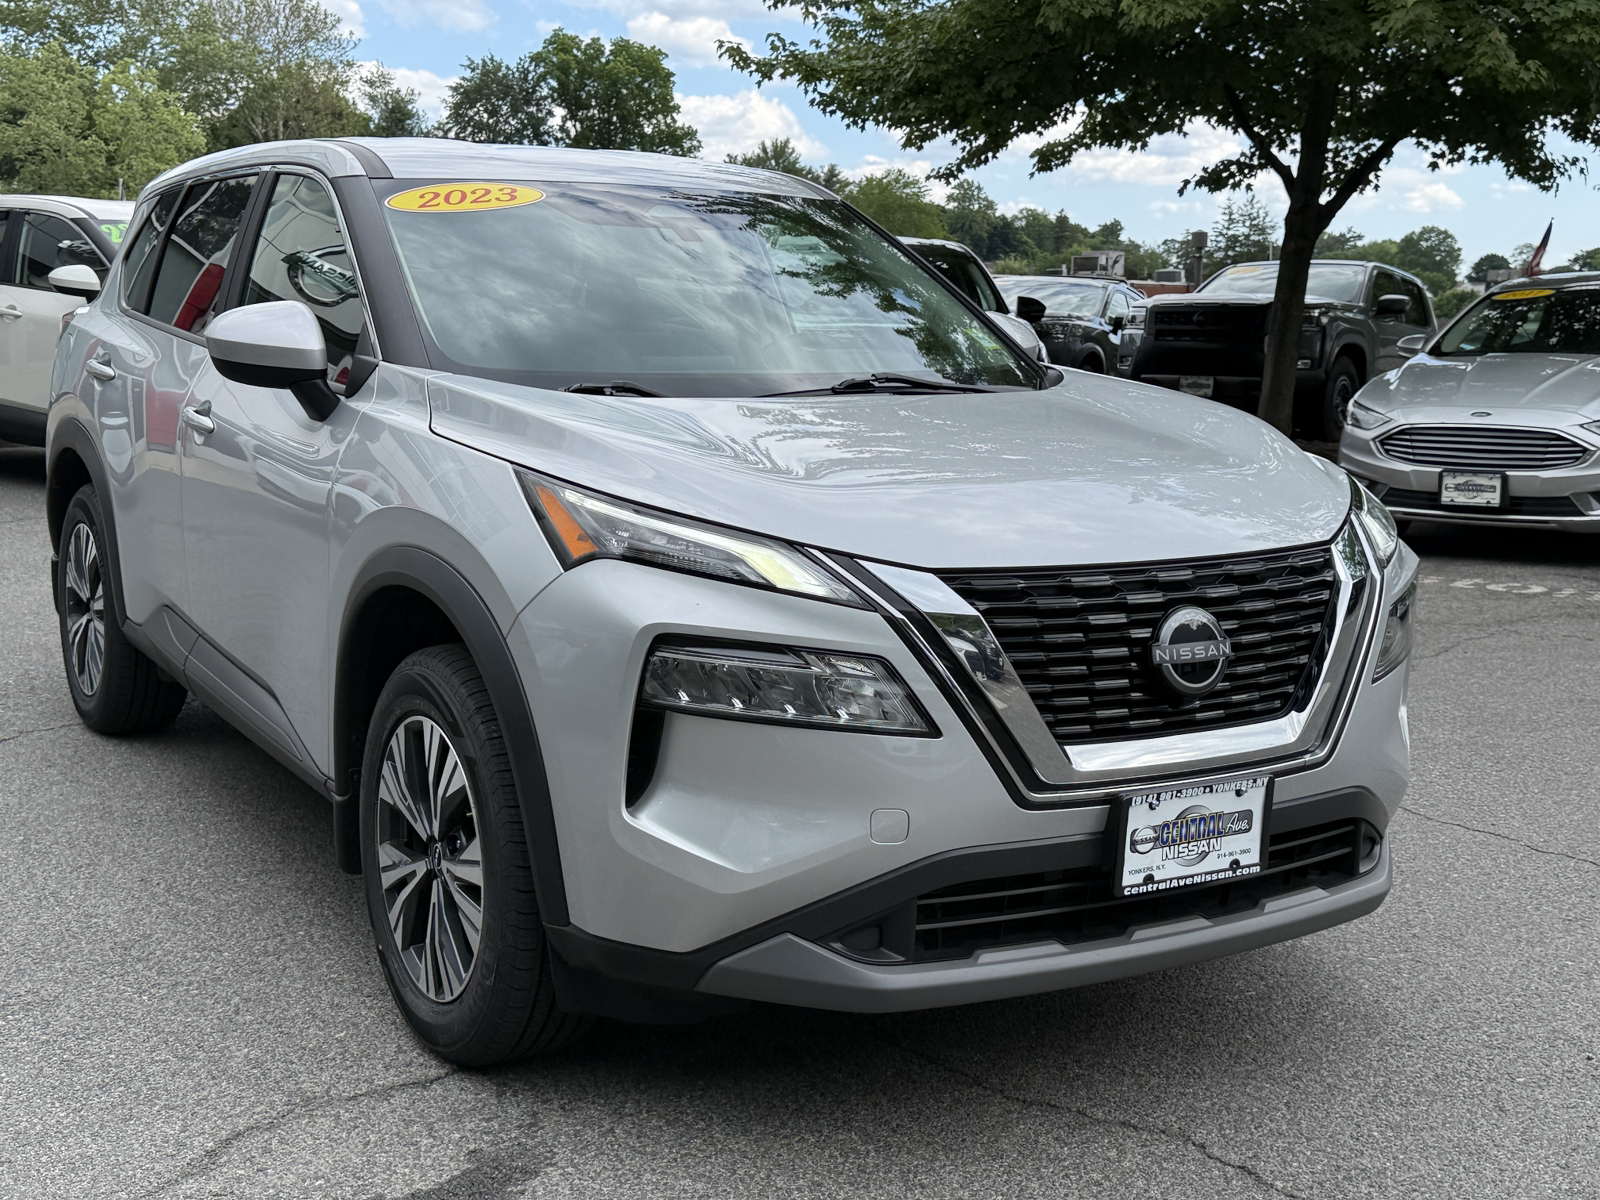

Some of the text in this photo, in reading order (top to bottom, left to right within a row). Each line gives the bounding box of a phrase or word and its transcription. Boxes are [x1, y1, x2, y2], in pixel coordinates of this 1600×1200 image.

[417, 187, 518, 209] 2023
[1155, 641, 1230, 661] NISSAN
[1159, 811, 1249, 846] CENTRAL Ave.
[1161, 838, 1222, 861] NISSAN
[1123, 865, 1260, 896] CentralAveNissan.com
